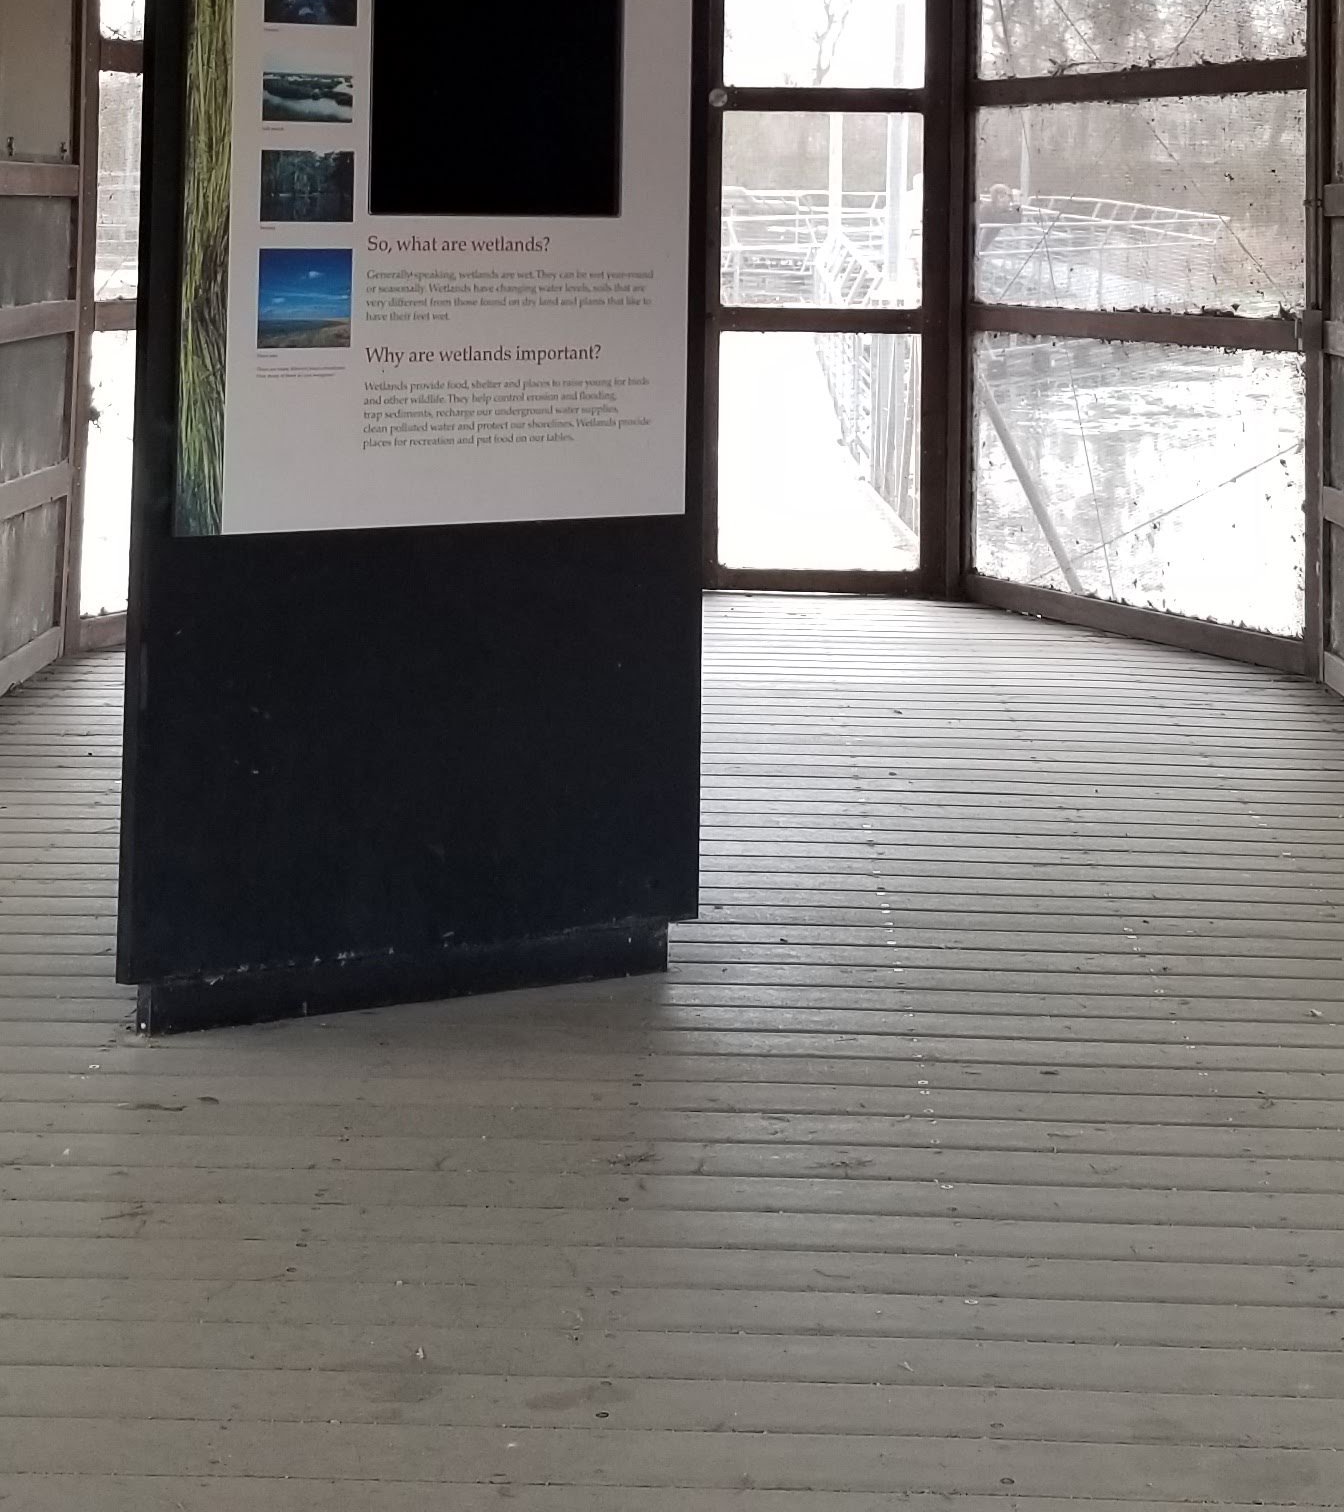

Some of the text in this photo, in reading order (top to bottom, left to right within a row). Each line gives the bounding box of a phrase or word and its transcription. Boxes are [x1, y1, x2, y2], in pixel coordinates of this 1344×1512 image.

[367, 236, 550, 253] So, what are wetlands?
[458, 269, 499, 279] wetlands
[535, 269, 557, 282] They
[428, 283, 470, 293] Wetlands
[473, 283, 495, 293] have
[366, 299, 386, 310] very
[387, 297, 427, 307] different
[430, 297, 452, 307] from
[454, 296, 477, 307] those
[480, 296, 506, 306] found
[539, 296, 559, 306] land
[366, 311, 387, 321] have
[389, 311, 411, 321] their
[413, 311, 430, 321] feet
[366, 344, 601, 367] Why are wetlands important?
[364, 381, 407, 391] Wetlands
[410, 380, 445, 393] provide
[471, 379, 501, 389] shelter
[523, 378, 551, 391] places
[383, 395, 407, 405] other
[447, 393, 468, 406] They
[471, 393, 491, 406] help
[493, 392, 524, 403] control
[526, 391, 558, 402] erosion
[363, 411, 382, 422] trap
[436, 407, 475, 420] recharge
[494, 405, 553, 418] underground
[555, 406, 579, 414] water
[363, 423, 387, 433] clean
[389, 422, 427, 436] polluted
[430, 423, 455, 432] water
[477, 421, 508, 433] protect
[576, 417, 616, 428] Wetlands
[362, 437, 392, 450] places
[409, 435, 455, 446] recreation
[494, 433, 513, 443] food
